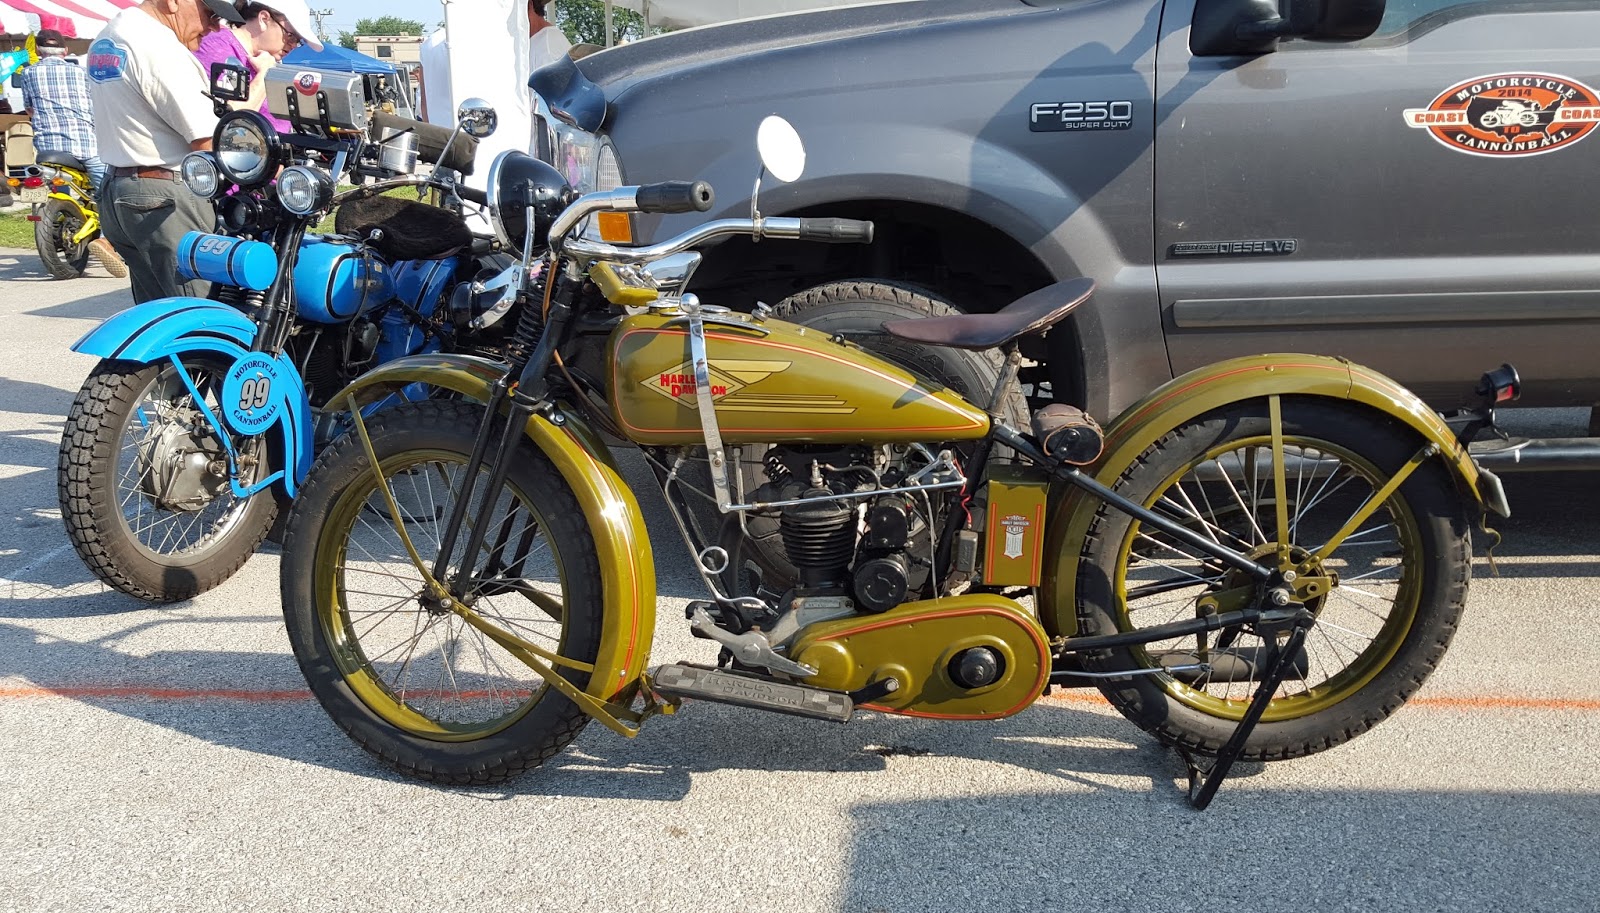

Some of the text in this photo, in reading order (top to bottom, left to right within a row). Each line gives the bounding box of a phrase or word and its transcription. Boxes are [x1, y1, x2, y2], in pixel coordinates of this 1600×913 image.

[1455, 77, 1577, 101] MOTORCYCLE
[1497, 88, 1532, 98] 2014
[1414, 108, 1600, 134] COAST TO COAS
[1455, 130, 1572, 152] CANNONBALL
[199, 238, 233, 255] 99
[1219, 241, 1274, 254] DIESEL
[1274, 240, 1296, 252] V8
[233, 360, 278, 381] MOTORCYCLE
[661, 374, 696, 386] HARLE
[239, 377, 271, 411] 99
[672, 385, 726, 397] DAVION
[233, 403, 278, 426] CANNONBALL
